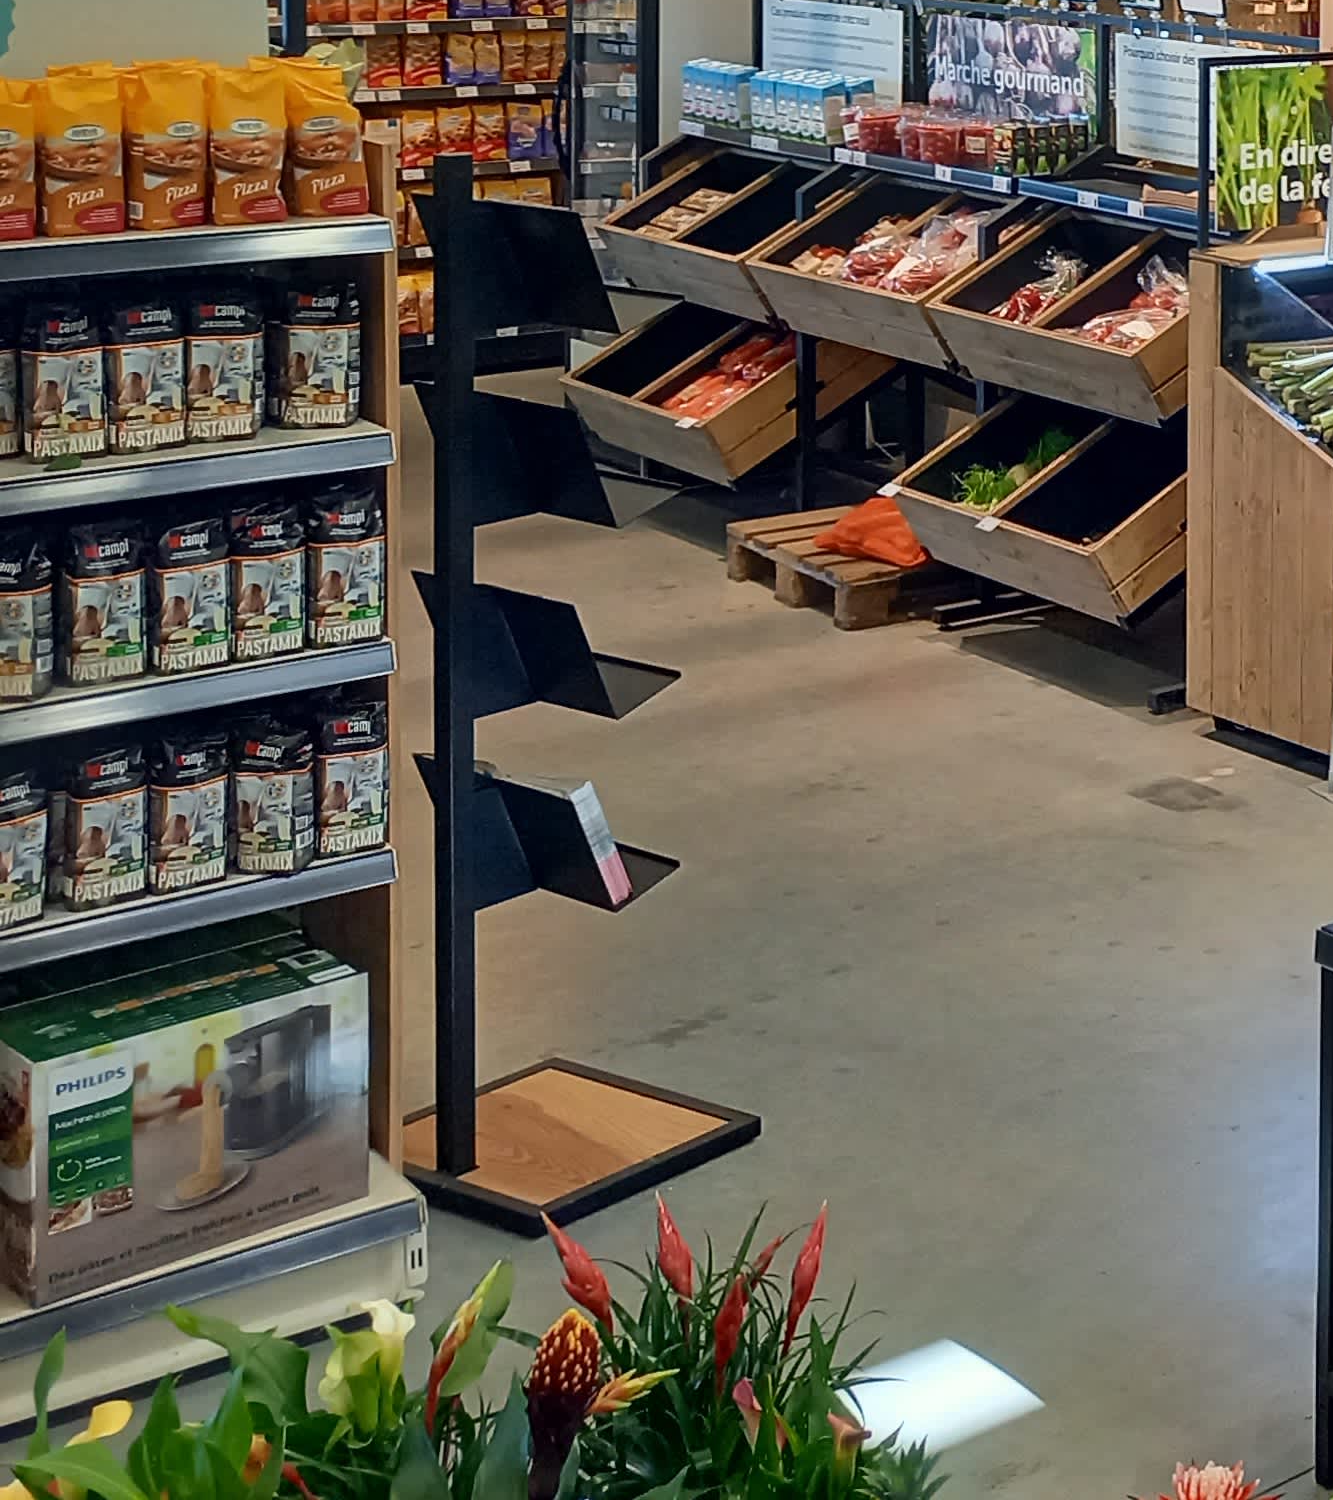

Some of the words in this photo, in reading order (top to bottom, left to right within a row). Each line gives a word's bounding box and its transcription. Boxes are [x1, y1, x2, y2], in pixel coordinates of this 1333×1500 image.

[993, 68, 1085, 97] gourmand
[1239, 142, 1274, 171] En
[1280, 139, 1333, 169] dire
[165, 182, 198, 204] Pizza
[232, 177, 269, 199] Pizza
[311, 171, 346, 194] Pizza
[1239, 176, 1273, 206] de
[1280, 173, 1304, 202] la
[1310, 172, 1331, 200] fe
[66, 186, 104, 209] Pizza
[283, 402, 347, 426] PASTAMIX
[33, 429, 105, 458] PASTAMIX
[119, 414, 186, 447] PASTAMIX
[338, 508, 366, 526] campi
[98, 537, 130, 558] campi
[180, 526, 209, 547] campi
[0, 560, 23, 576] ampi
[316, 618, 382, 645] PASTAMIX
[160, 641, 229, 671] PASTAMIX
[236, 632, 303, 658] PASTAMIX
[72, 653, 144, 682] PASTAMIX
[99, 756, 129, 777] campi
[320, 823, 385, 852] PASTAMIX
[158, 856, 225, 889] PASTAMIX
[239, 850, 295, 873] ASTAMIX
[74, 868, 145, 903] PASTAMIX
[55, 1066, 127, 1096] PHILIPS
